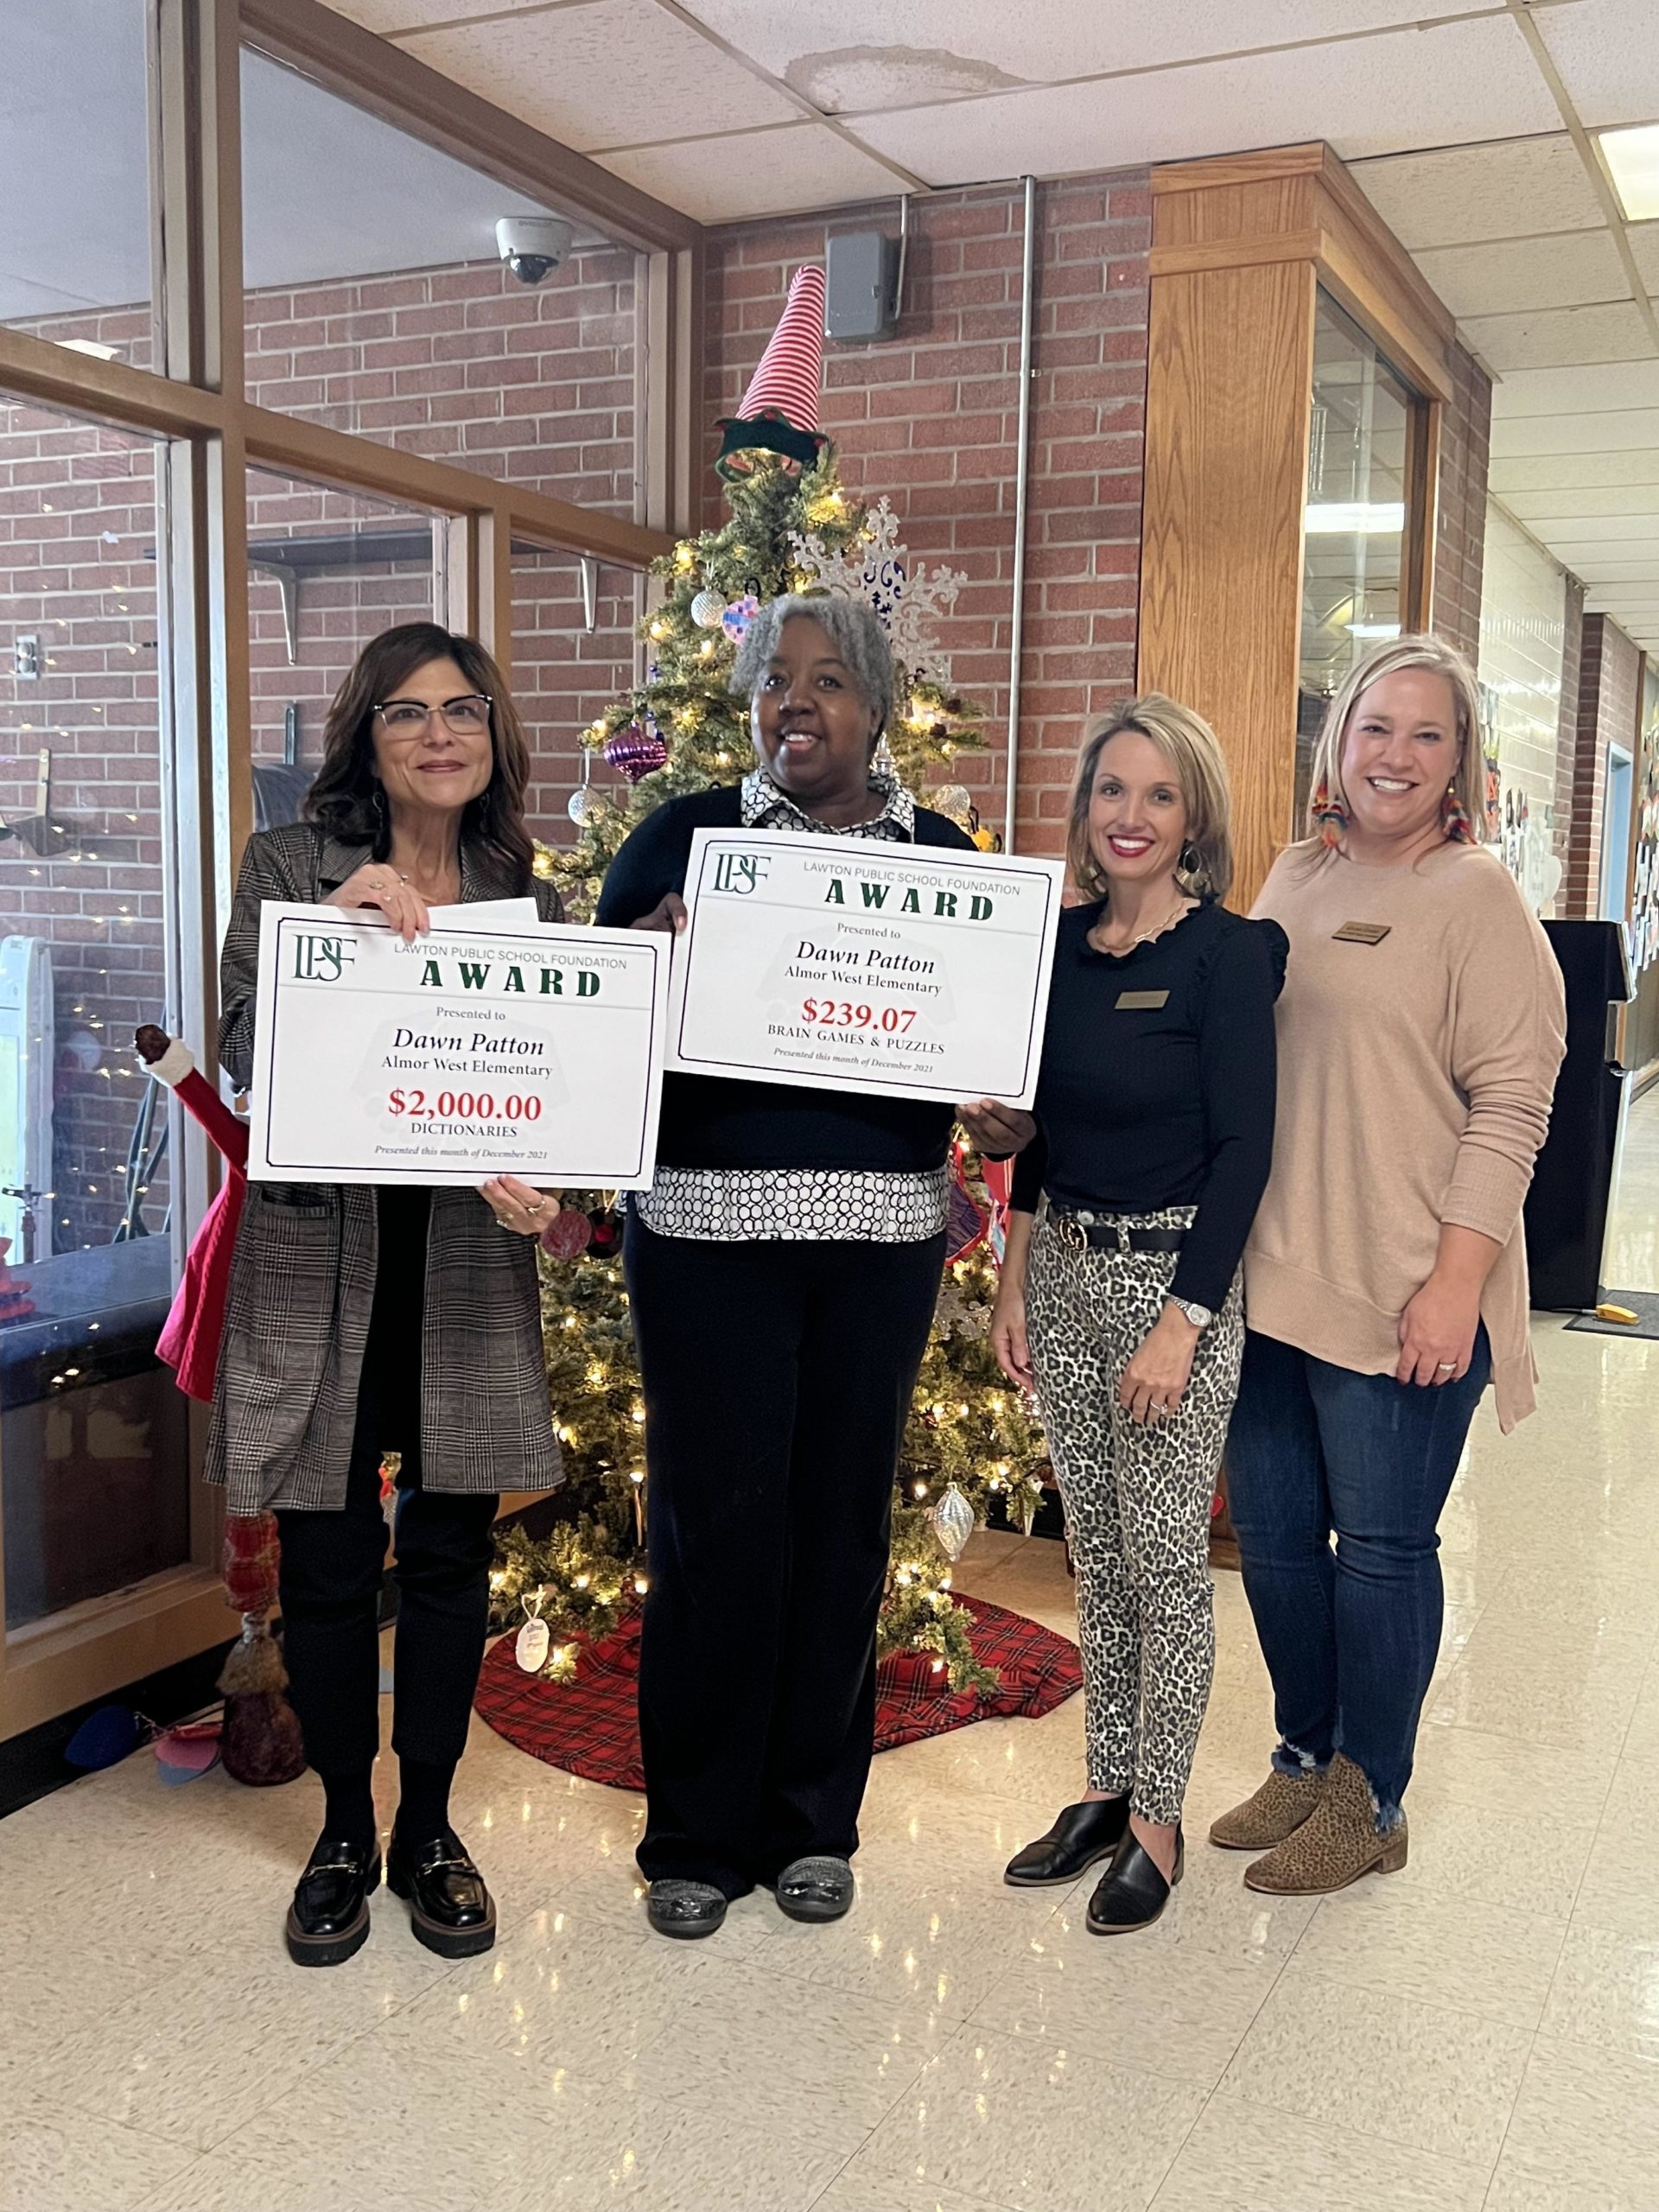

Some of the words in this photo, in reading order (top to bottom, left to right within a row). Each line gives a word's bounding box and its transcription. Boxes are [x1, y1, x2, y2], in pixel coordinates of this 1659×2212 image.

[804, 861, 852, 876] LAWTON
[855, 868, 894, 881] PUBLIC
[898, 873, 944, 887] SCHOOL
[947, 878, 1021, 895] FOUNDATION
[824, 878, 994, 921] AWARD
[837, 923, 887, 938] Presented
[890, 929, 900, 938] to
[394, 943, 448, 957] LAWTON
[452, 947, 495, 960] PUBLIC
[499, 951, 548, 964] SCHOOL
[551, 954, 627, 969] FOUNDATION
[796, 940, 859, 965] Dawn
[864, 949, 935, 974] Patton
[420, 960, 601, 997] AWARD
[785, 965, 828, 981] Almor
[831, 970, 862, 984] West
[867, 975, 942, 996] Elementary
[436, 1007, 491, 1020] Presented
[495, 1011, 505, 1020] to
[802, 996, 918, 1033] $239.07
[392, 1028, 462, 1051] Dawn
[468, 1033, 544, 1056] Patton
[768, 1024, 811, 1039] BRAIN
[817, 1030, 864, 1045] GAMES
[870, 1037, 880, 1047] &
[887, 1038, 945, 1054] PUZZLES
[381, 1056, 429, 1070] Almor
[434, 1058, 467, 1071] West
[473, 1060, 553, 1080] Elementary
[773, 1047, 814, 1059] Presented
[815, 1052, 831, 1061] this
[832, 1055, 860, 1065] month
[861, 1057, 870, 1067] of
[871, 1058, 912, 1071] December
[913, 1064, 933, 1073] 2021
[389, 1087, 542, 1121] $2,000.00
[411, 1122, 518, 1137] DICTIONARIES
[374, 1145, 419, 1155] Presented
[421, 1147, 438, 1156] this
[440, 1148, 469, 1157] month
[471, 1148, 480, 1159] of
[482, 1149, 525, 1159] December
[527, 1151, 548, 1160] 2021
